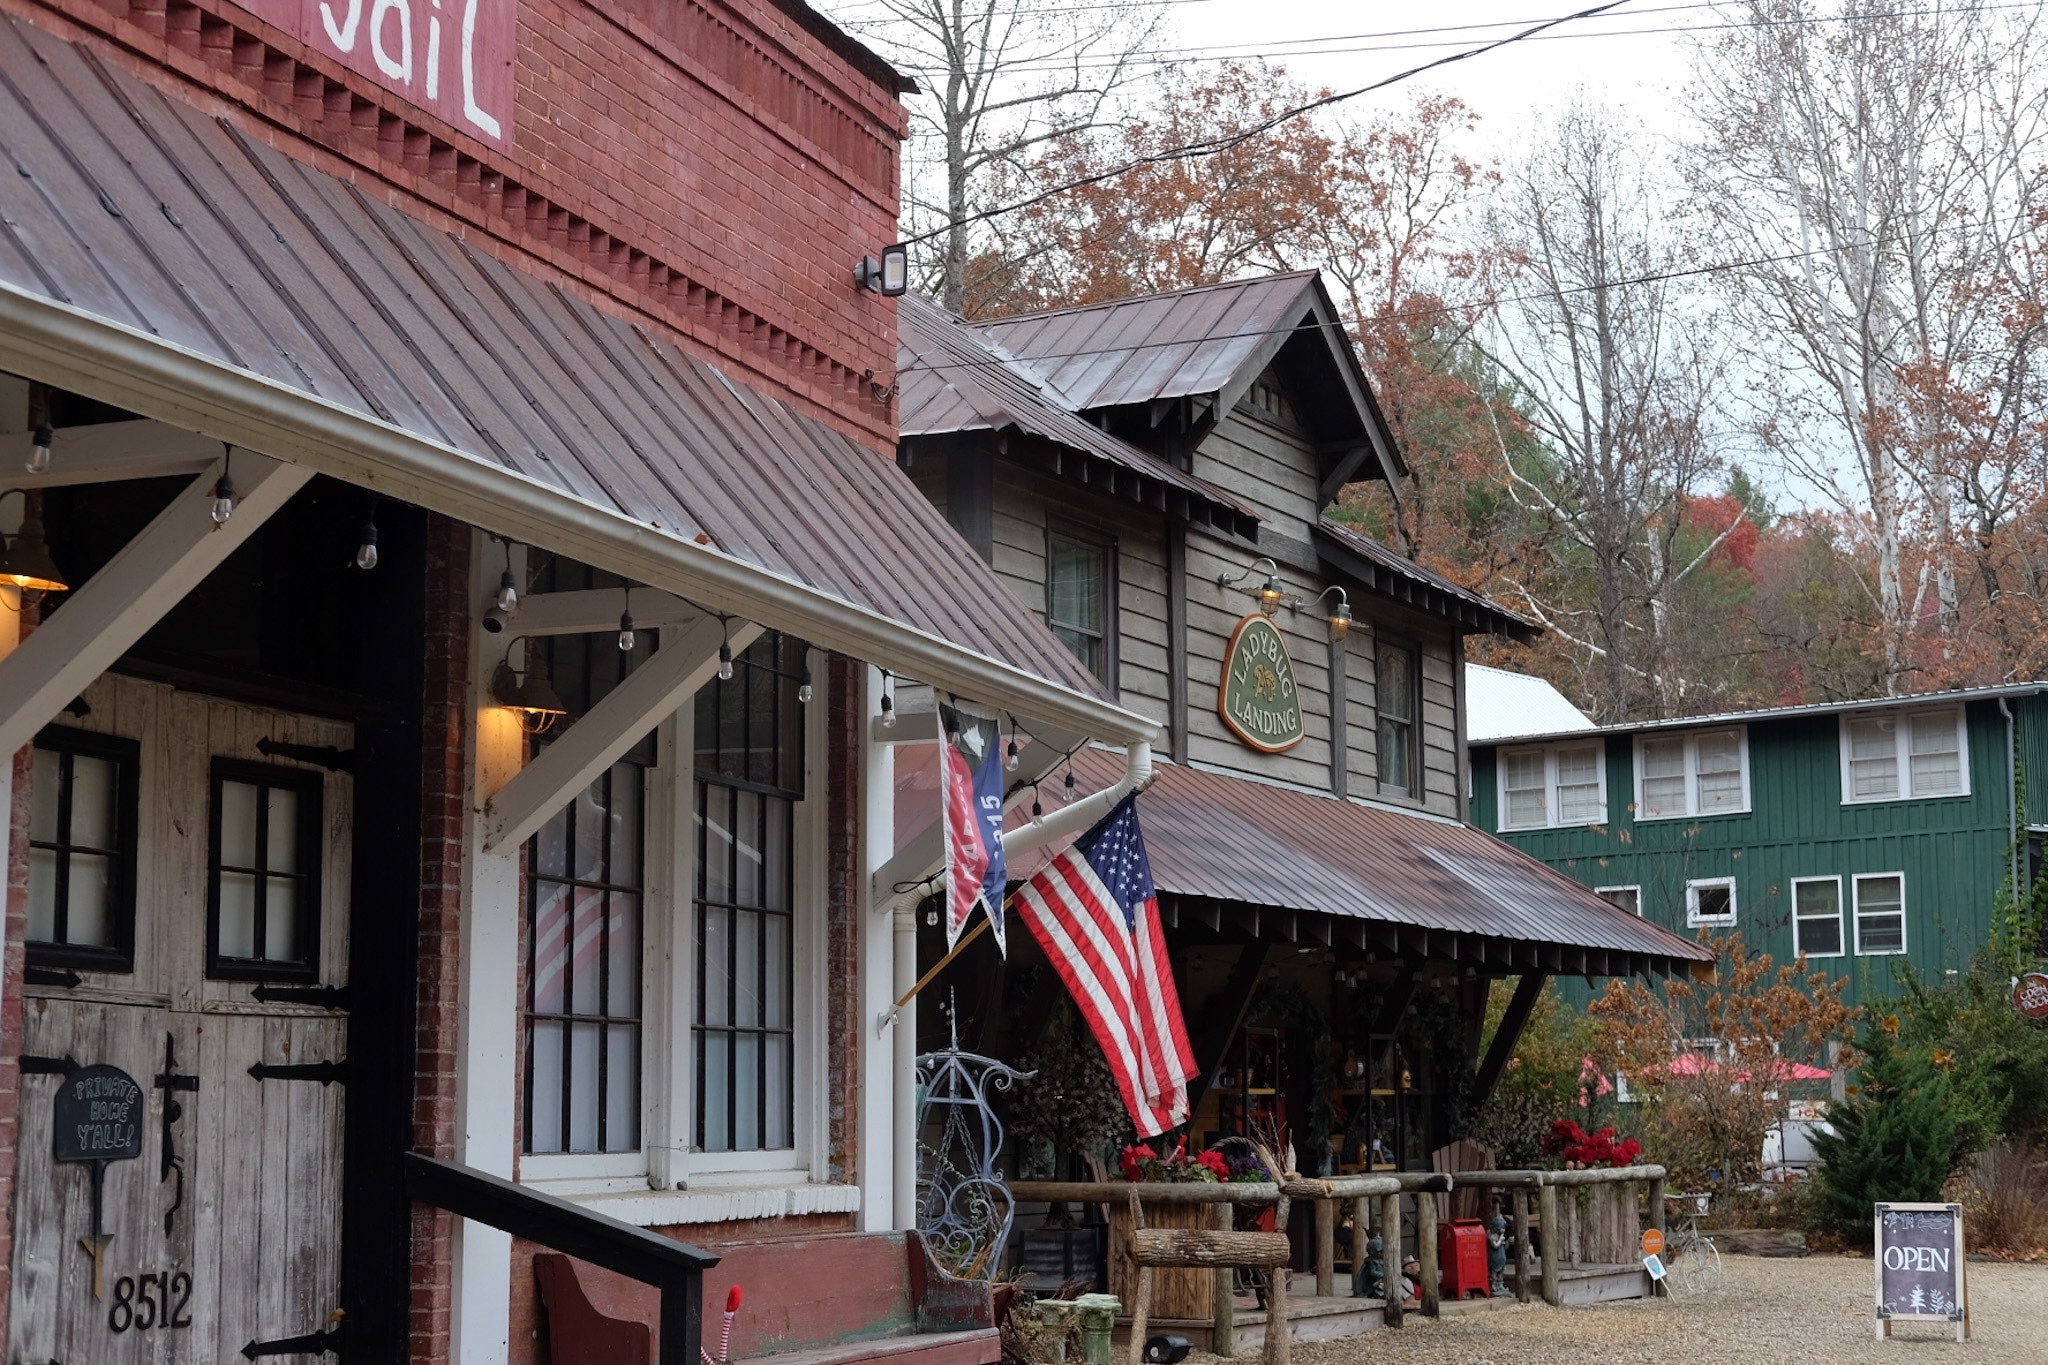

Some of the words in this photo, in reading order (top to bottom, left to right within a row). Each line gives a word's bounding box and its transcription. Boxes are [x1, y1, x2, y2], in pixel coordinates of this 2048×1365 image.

[1234, 631, 1293, 700] LADYBUG
[1234, 693, 1297, 736] LANDING
[76, 1077, 139, 1104] PRIVATE
[91, 1101, 129, 1122] HOME
[77, 1124, 135, 1150] Y'ALL!
[1884, 1246, 1950, 1273] OPEN
[109, 1271, 192, 1333] 8512
